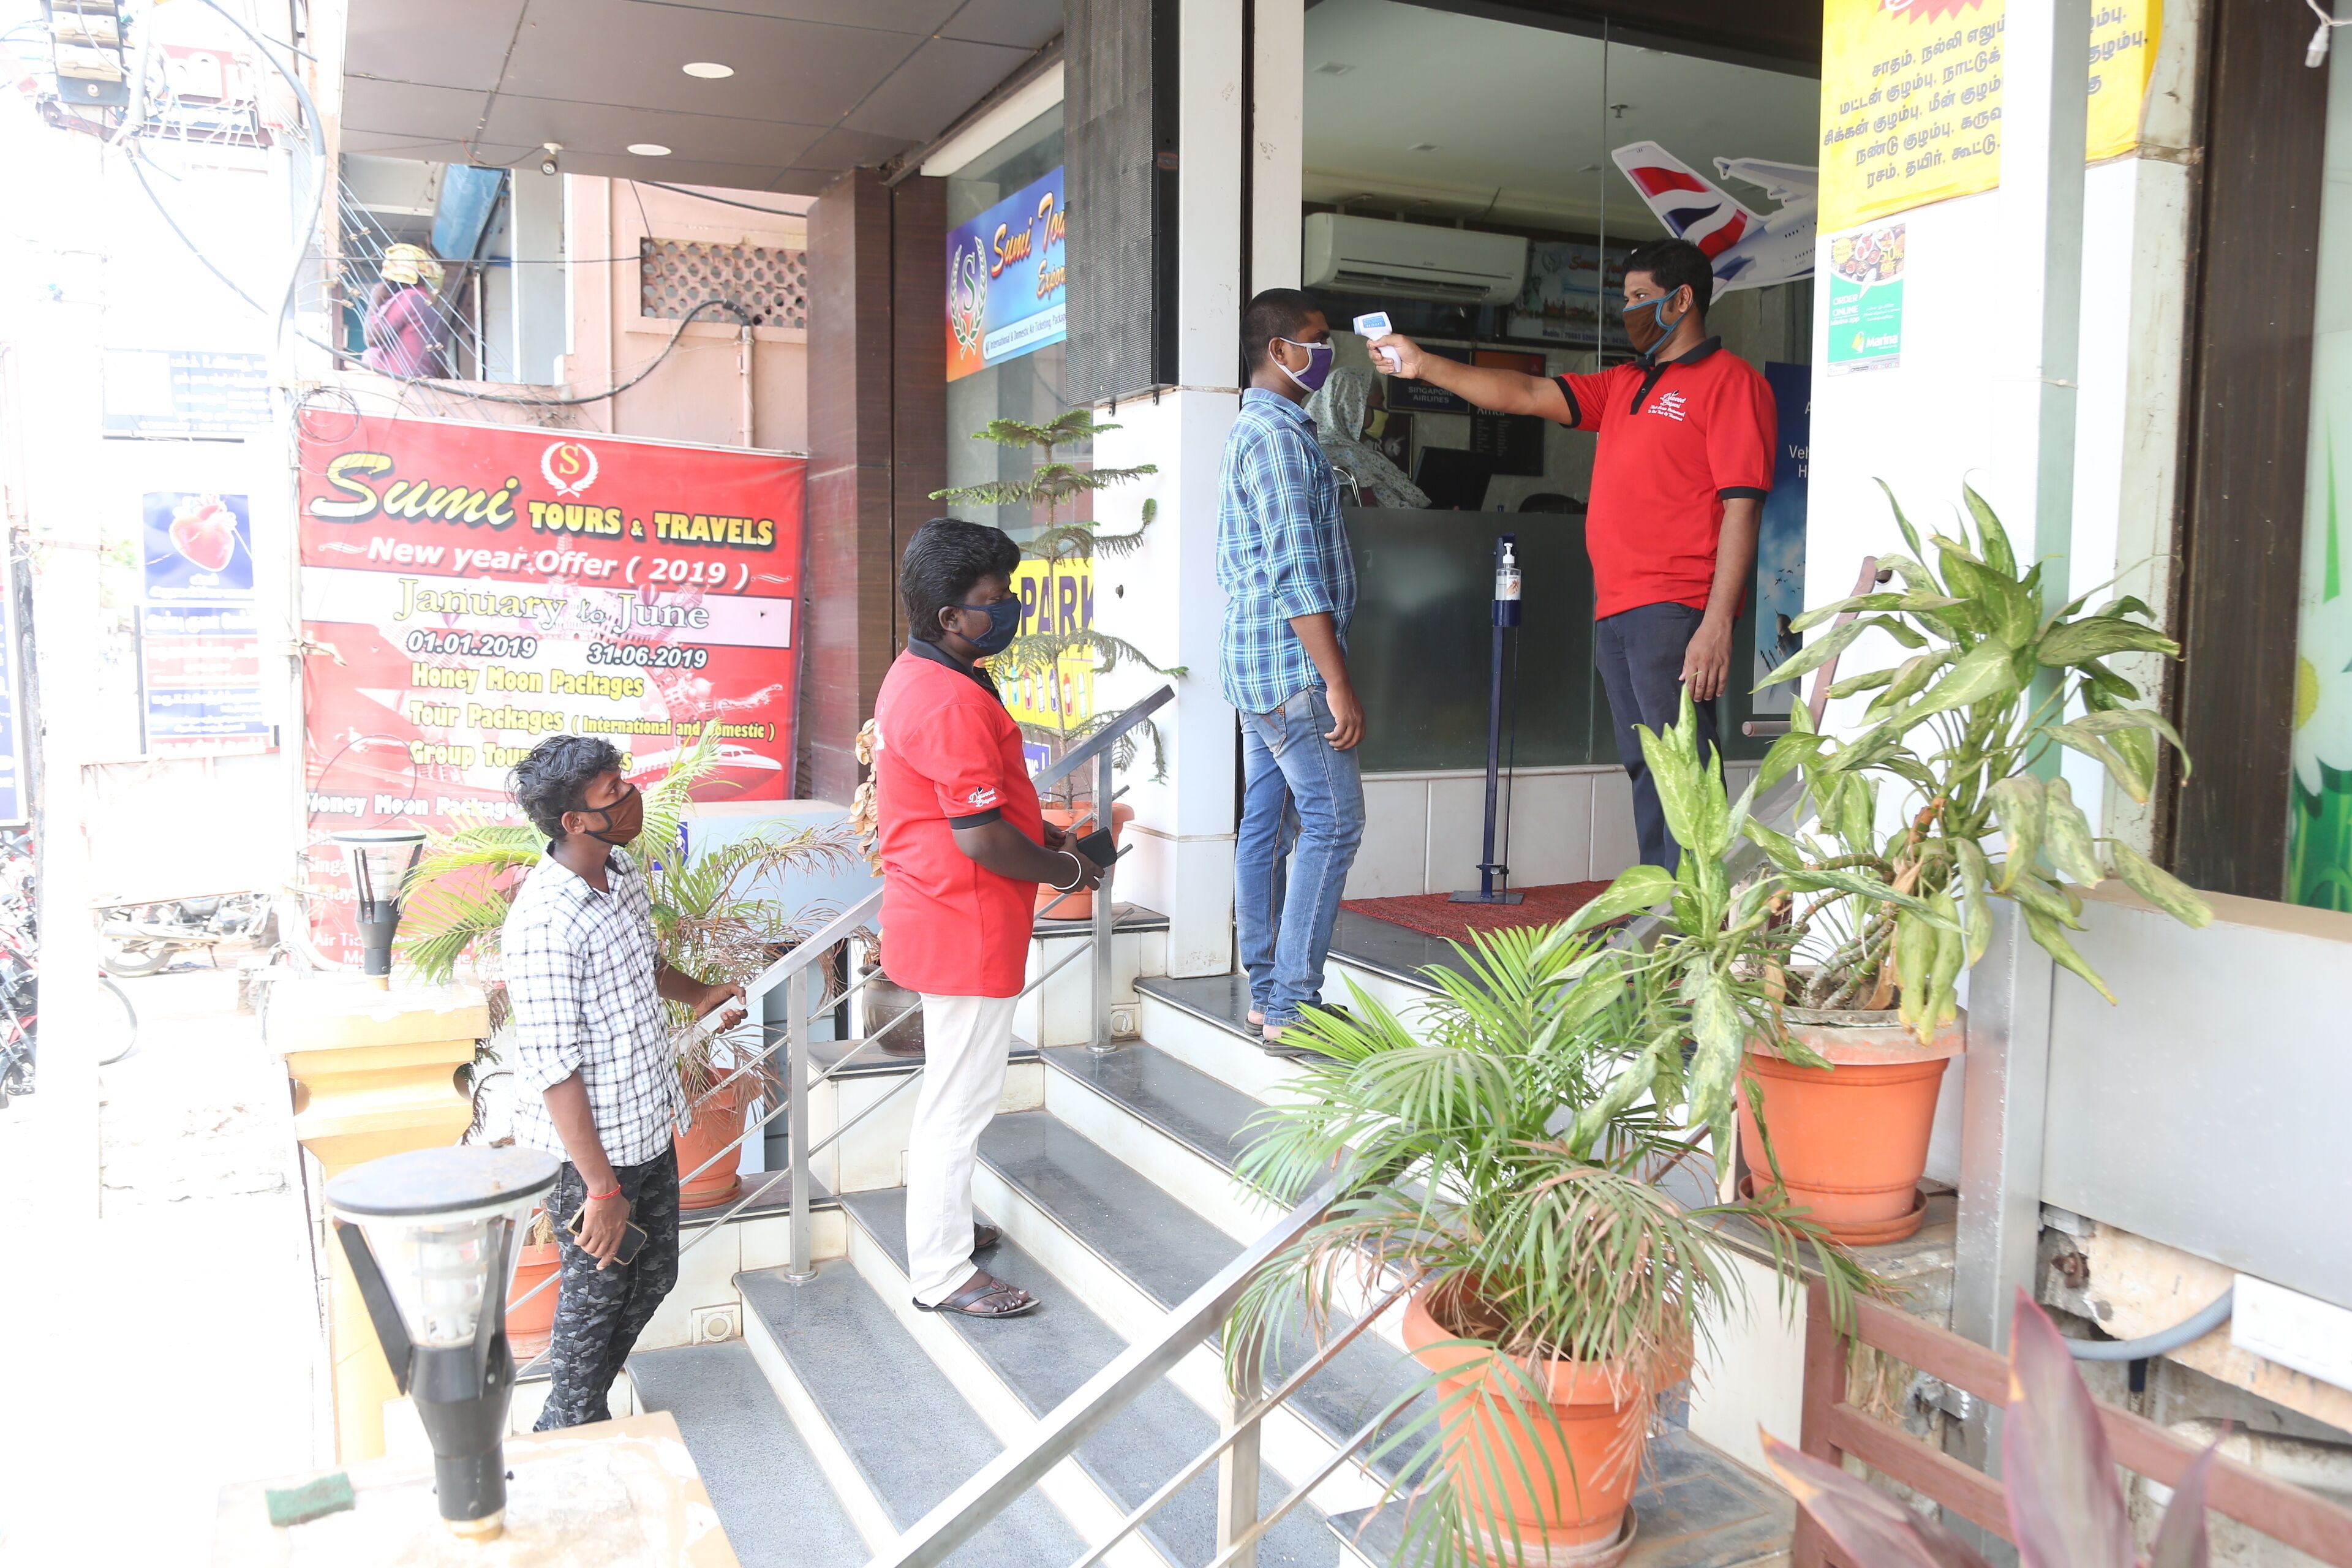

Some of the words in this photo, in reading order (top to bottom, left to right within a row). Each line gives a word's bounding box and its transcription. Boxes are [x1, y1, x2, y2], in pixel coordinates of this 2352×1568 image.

[1921, 31, 1962, 65] நல்லி
[1823, 118, 1869, 146] சிக்கன்
[1929, 89, 1956, 113] மீன்
[1961, 74, 2003, 105] குழம்
[1839, 87, 1882, 115] மட்டன்
[1856, 137, 1899, 167] நண்டு
[990, 216, 1033, 278] Sumi
[1038, 191, 1065, 253] Tou
[1880, 263, 1895, 271] OFF
[1833, 294, 1858, 305] ORDER
[1833, 305, 1859, 316] ONLINE
[1866, 334, 1898, 348] Marina
[1408, 386, 1453, 396] SINGAPORE
[1413, 394, 1450, 404] AIRLINES
[1789, 445, 1809, 460] Veh
[310, 452, 519, 527] Sumi
[529, 501, 622, 535] TOURS
[630, 518, 644, 537] &
[654, 513, 774, 546] TRAVELS
[368, 537, 445, 564] New
[453, 548, 528, 571] year
[535, 550, 618, 576] Offer
[649, 558, 726, 584] 2019
[393, 578, 567, 630] January
[577, 599, 606, 624] to
[612, 593, 709, 634] June
[407, 629, 538, 659] 01.01.2019
[587, 643, 709, 669] 31.06.2019
[411, 661, 480, 695] Honey
[486, 665, 543, 693] Moon
[550, 668, 644, 701] Packages
[409, 700, 461, 728] Tour
[467, 703, 565, 735] Packages
[582, 715, 672, 736] International
[676, 720, 701, 736] and
[409, 739, 475, 771] Group
[374, 793, 429, 816] Moon
[435, 796, 518, 821] Package
[312, 932, 336, 946] Air
